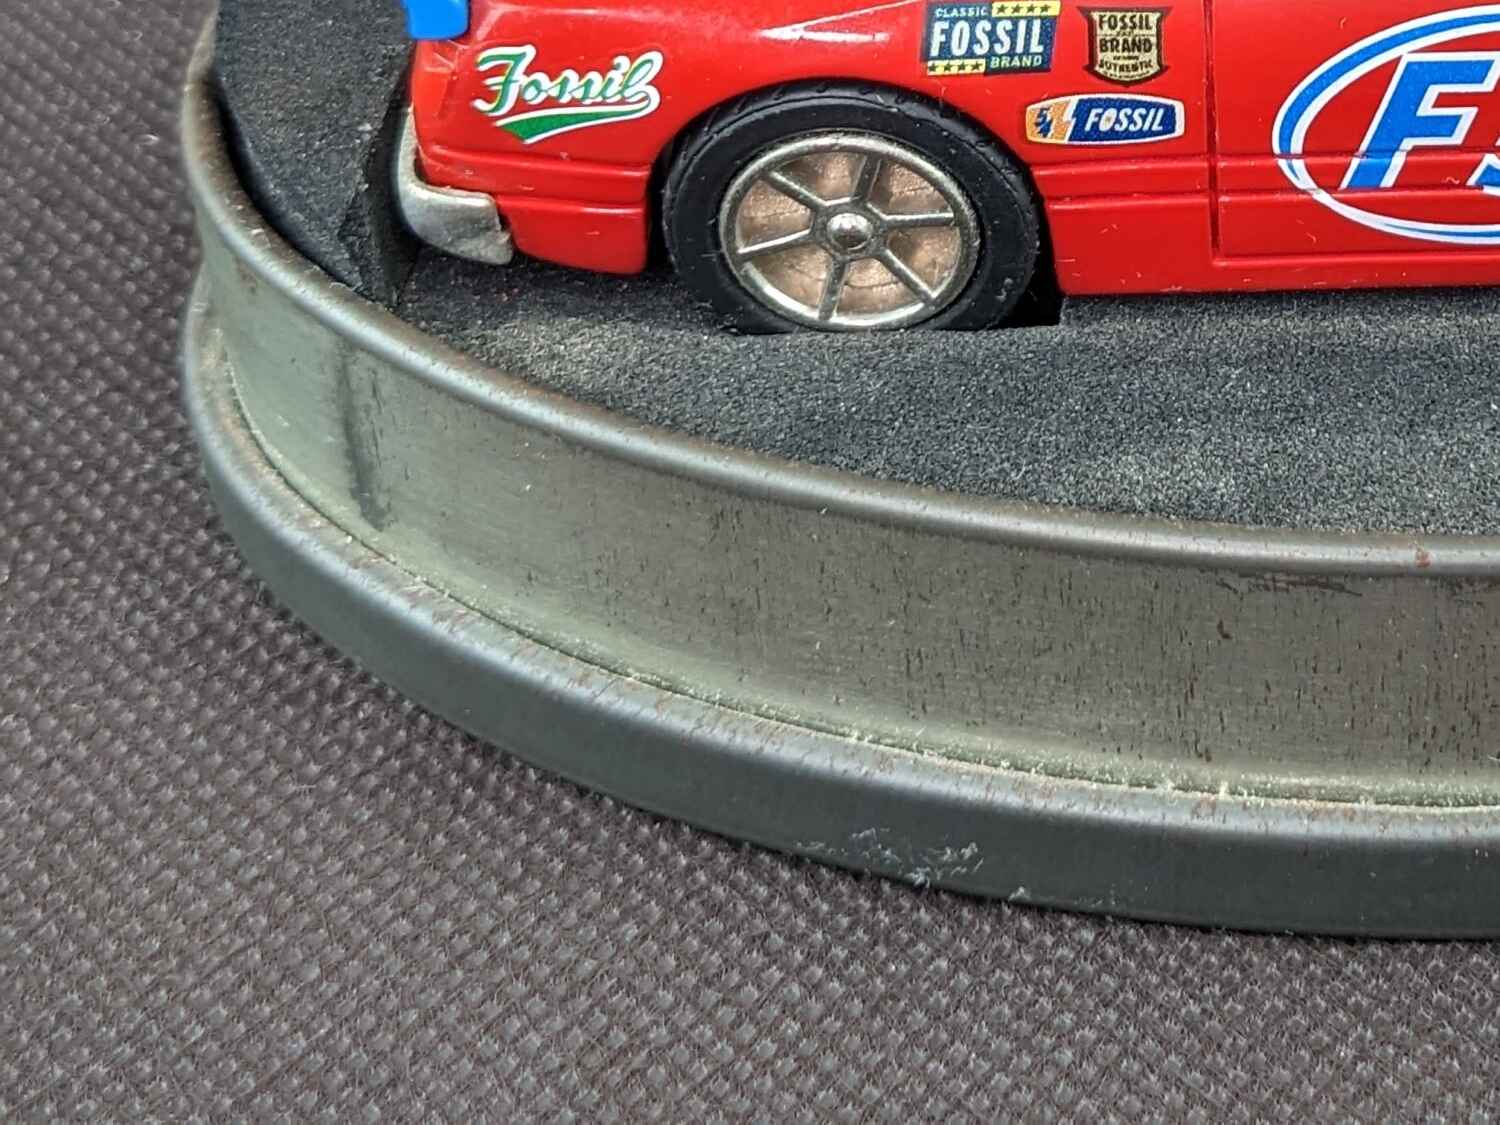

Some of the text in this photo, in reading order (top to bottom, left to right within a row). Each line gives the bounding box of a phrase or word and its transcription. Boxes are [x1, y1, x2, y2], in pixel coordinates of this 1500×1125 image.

[935, 6, 988, 18] CLASSIC
[1098, 14, 1153, 30] FOSSIL
[929, 19, 1044, 57] FOSSIL
[1098, 37, 1153, 53] BRAND
[990, 55, 1043, 69] BRAND
[471, 44, 663, 117] Fossil
[1084, 107, 1165, 132] FOSSIL
